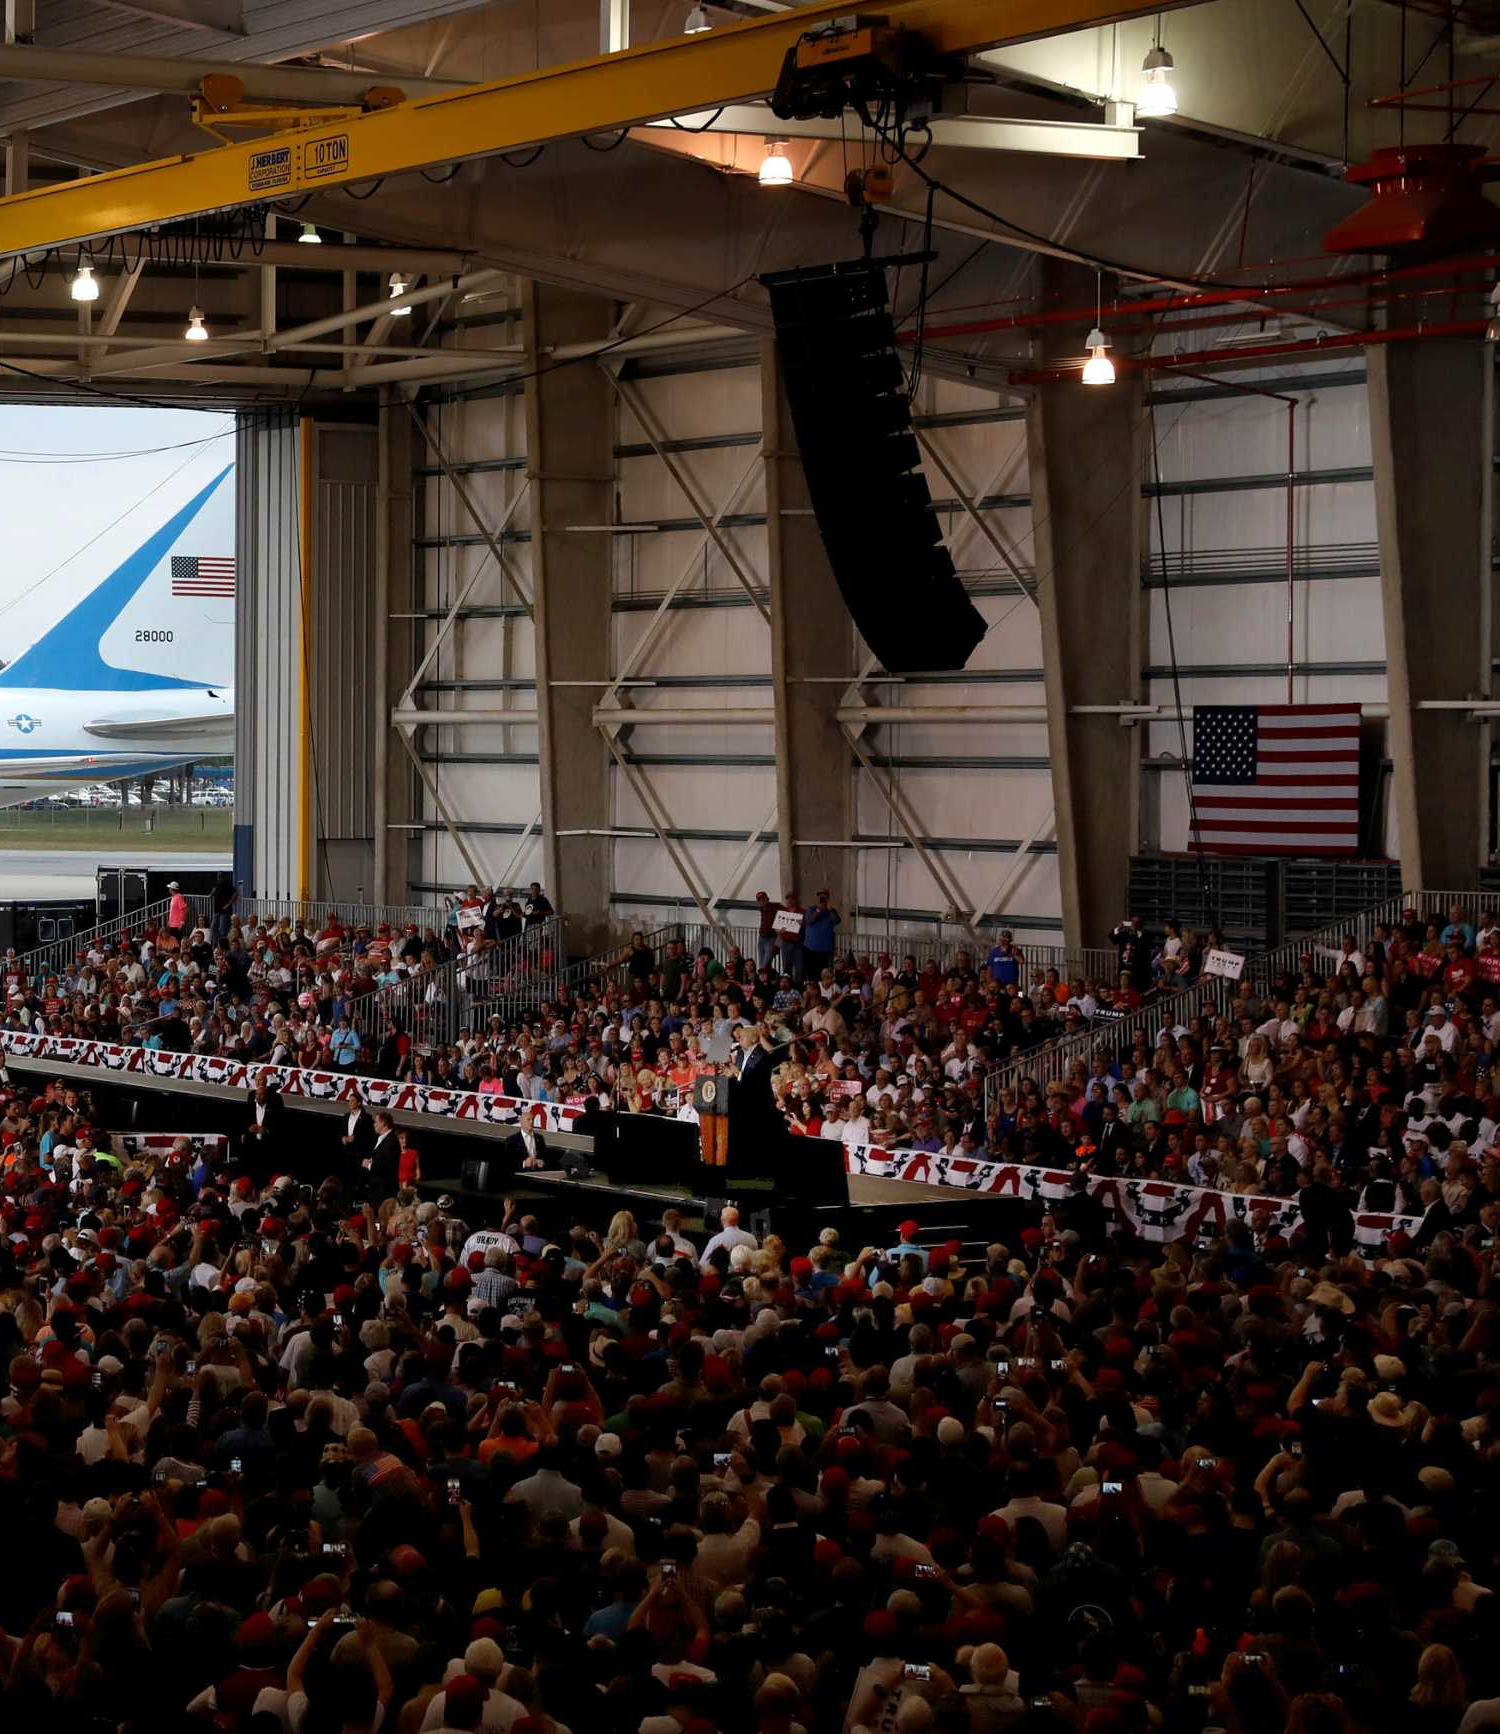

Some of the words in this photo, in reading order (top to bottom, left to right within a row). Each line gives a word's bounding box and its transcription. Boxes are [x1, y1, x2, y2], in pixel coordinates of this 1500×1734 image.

[315, 142, 325, 164] 10
[326, 137, 346, 161] TON
[249, 163, 291, 179] CORPORATION
[135, 630, 174, 643] 28000
[1211, 956, 1240, 967] TRUMP
[1094, 1008, 1125, 1018] TRUMP
